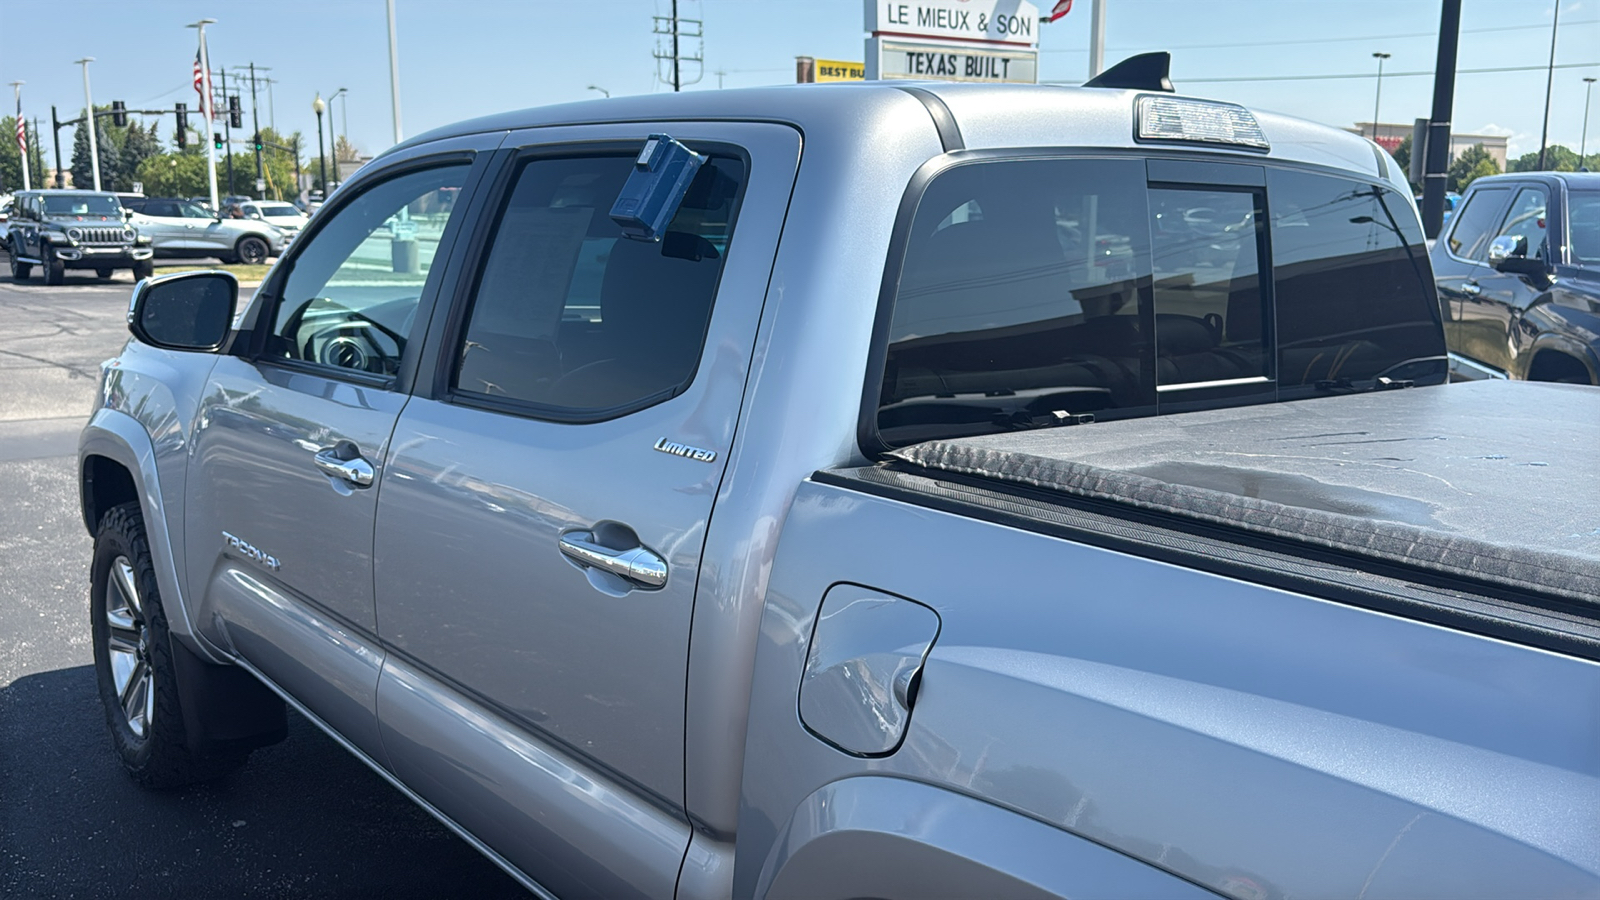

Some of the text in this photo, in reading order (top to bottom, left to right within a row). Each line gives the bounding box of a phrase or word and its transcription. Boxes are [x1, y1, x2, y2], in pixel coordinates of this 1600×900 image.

[888, 3, 1031, 36] LE MIEUX & SON
[820, 66, 865, 79] BEST BU
[906, 51, 1010, 79] TEXAS BUILT
[221, 530, 281, 571] TACOMA
